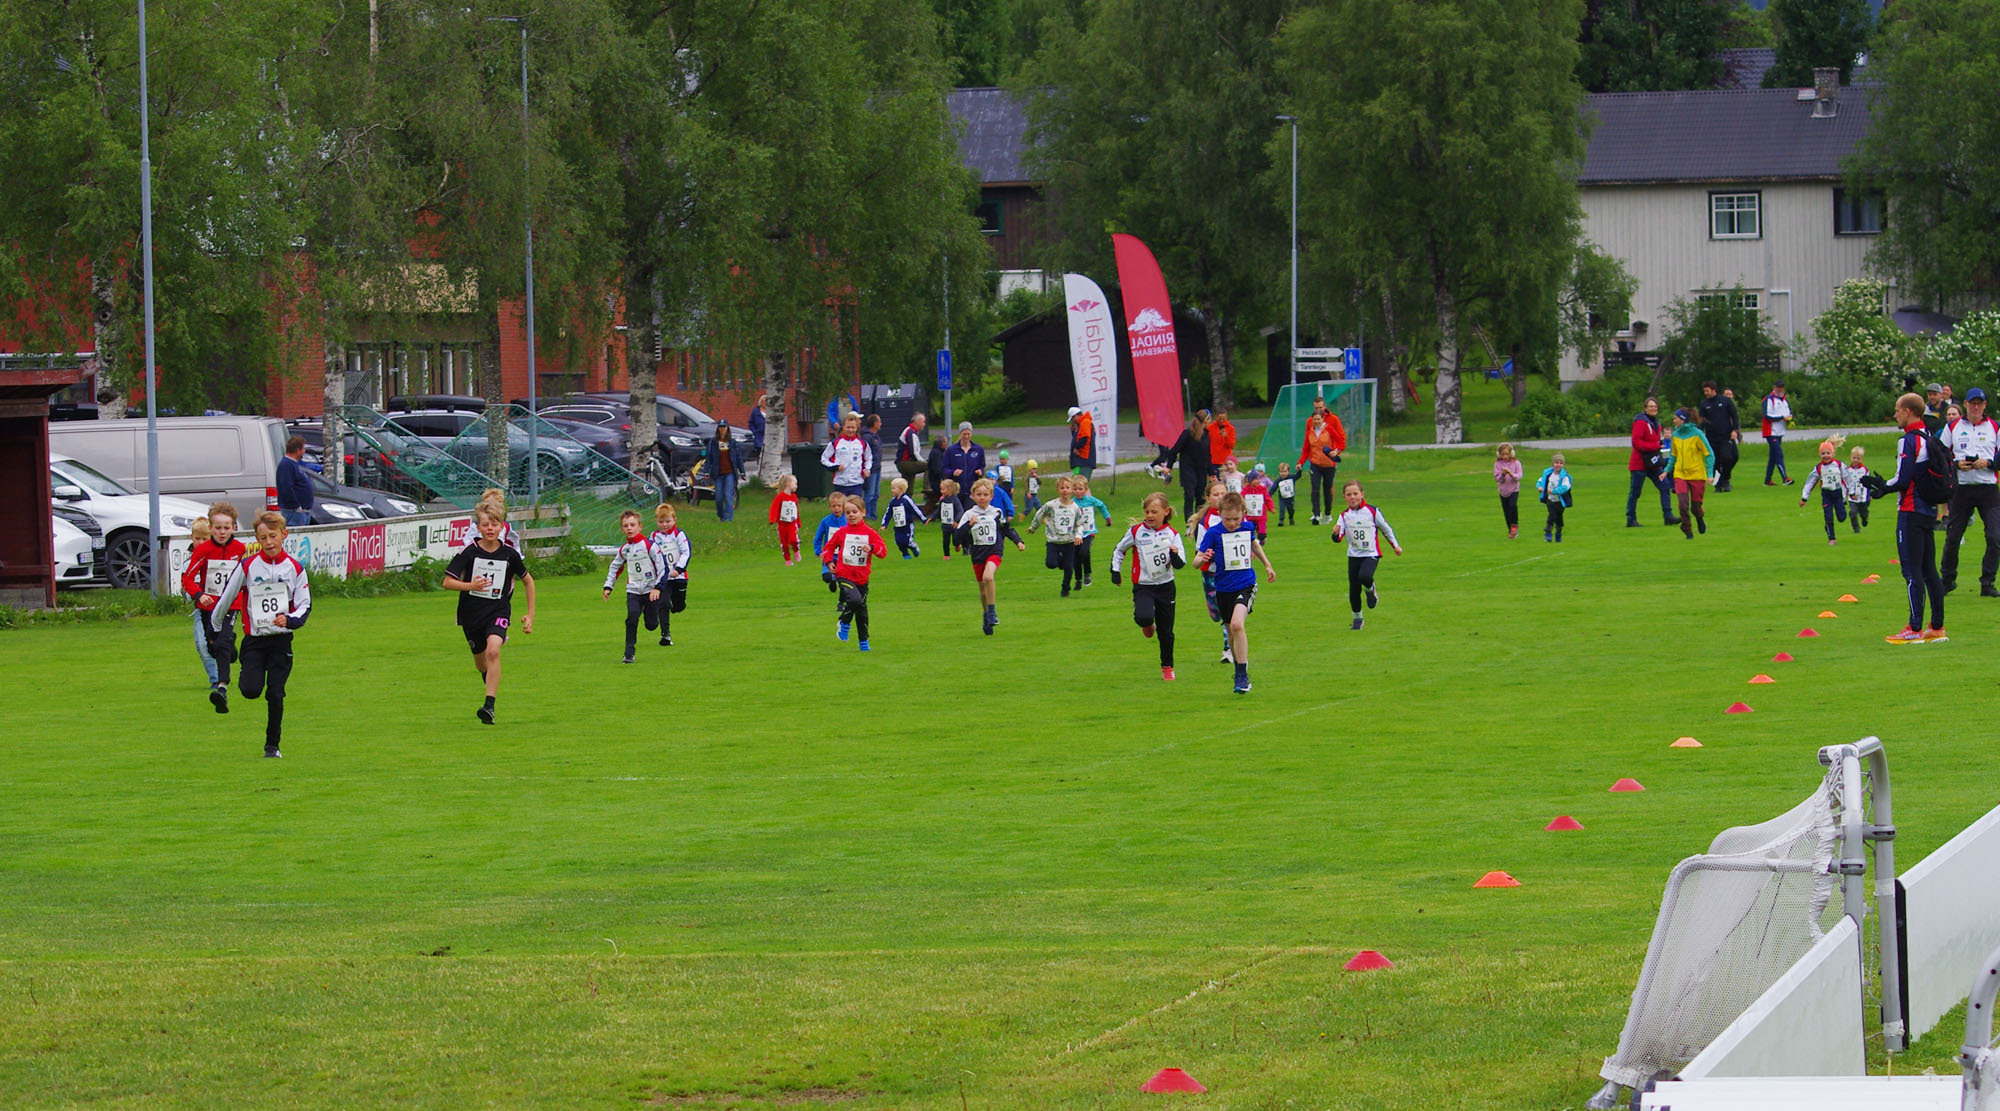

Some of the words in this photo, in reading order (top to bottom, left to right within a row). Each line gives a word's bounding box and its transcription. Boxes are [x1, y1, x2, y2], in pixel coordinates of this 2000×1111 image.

[1827, 475, 1836, 483] 24
[1251, 501, 1257, 510] 9
[785, 508, 793, 516] 51
[1060, 517, 1070, 526] 29
[978, 525, 990, 536] 30
[1353, 530, 1365, 540] 38
[350, 527, 384, 561] Rindal
[850, 545, 862, 557] 35
[1232, 544, 1246, 557] 10
[312, 544, 347, 571] Statkraft
[1153, 552, 1167, 567] 69
[634, 562, 642, 573] 8
[214, 572, 228, 585] 31
[262, 597, 279, 613] 68
